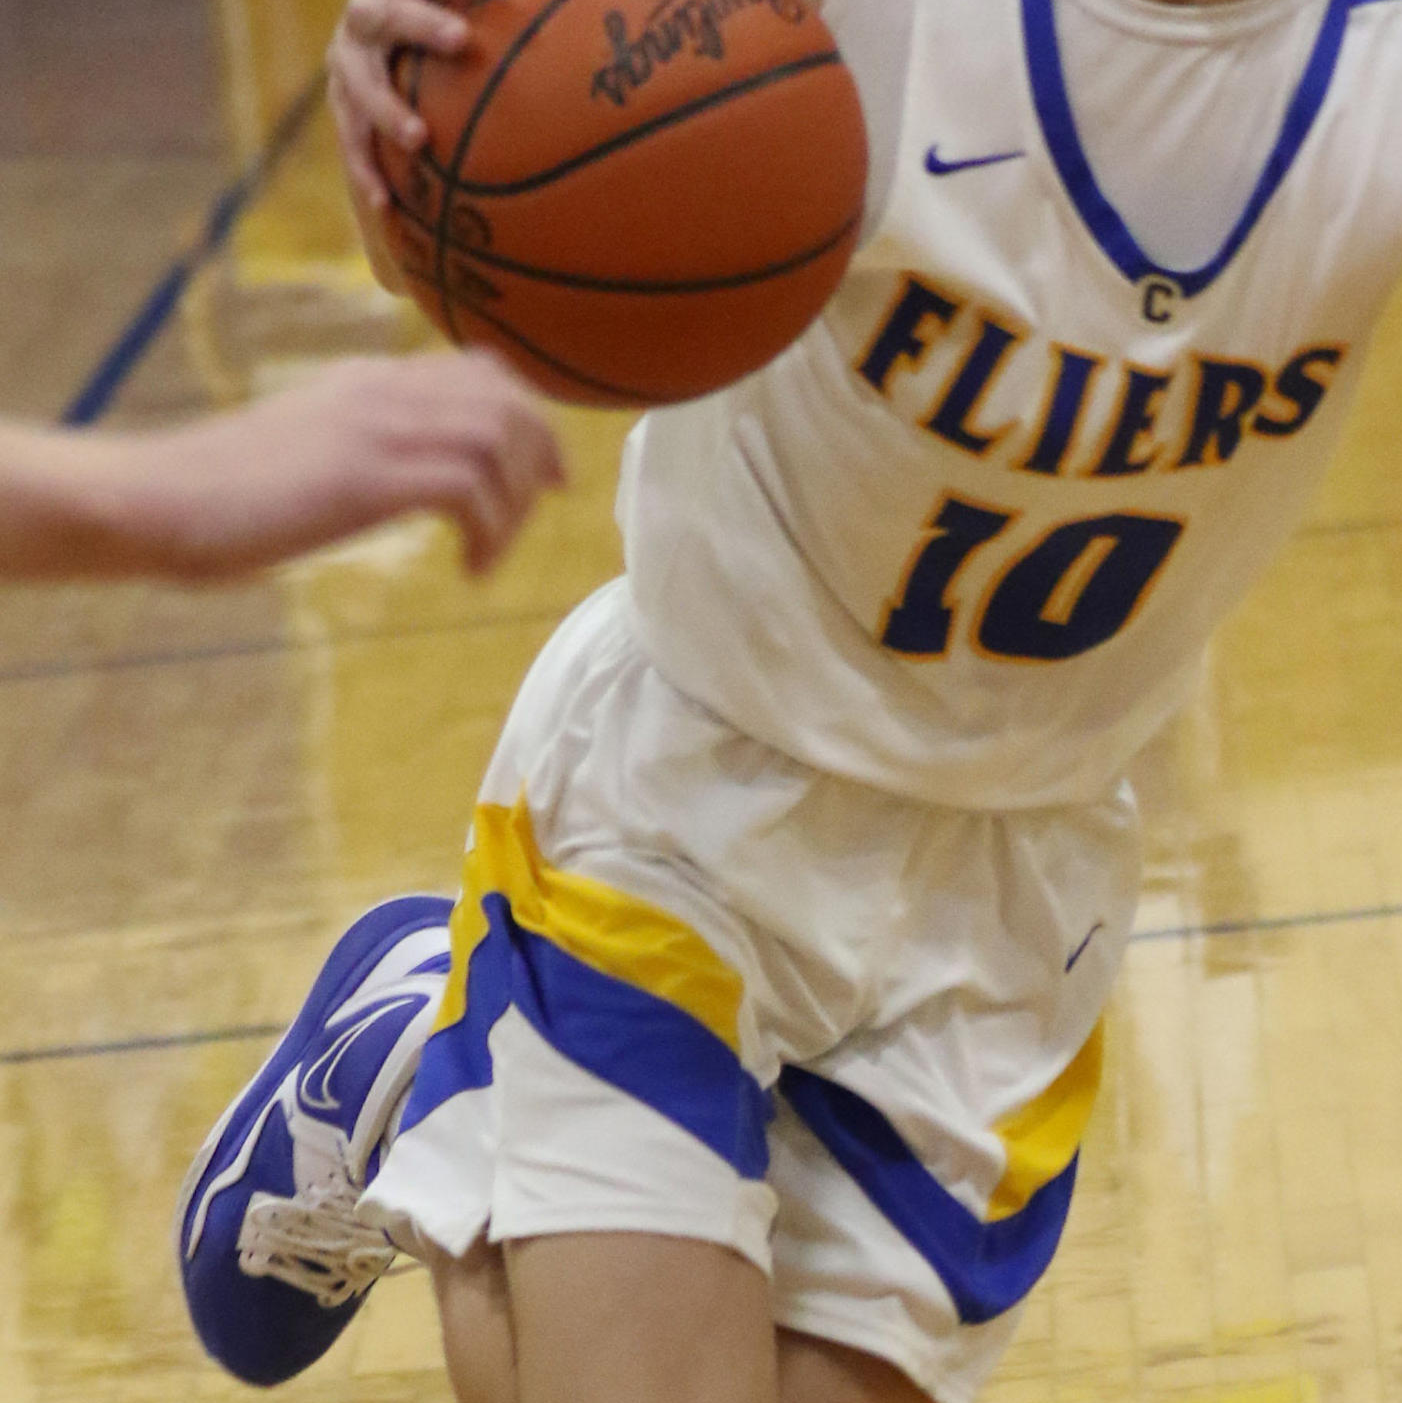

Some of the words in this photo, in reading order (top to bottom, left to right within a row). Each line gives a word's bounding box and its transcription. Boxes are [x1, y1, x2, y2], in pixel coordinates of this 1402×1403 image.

[855, 271, 1350, 479] FLIERS
[1142, 282, 1174, 324] C
[879, 490, 1189, 662] 10
